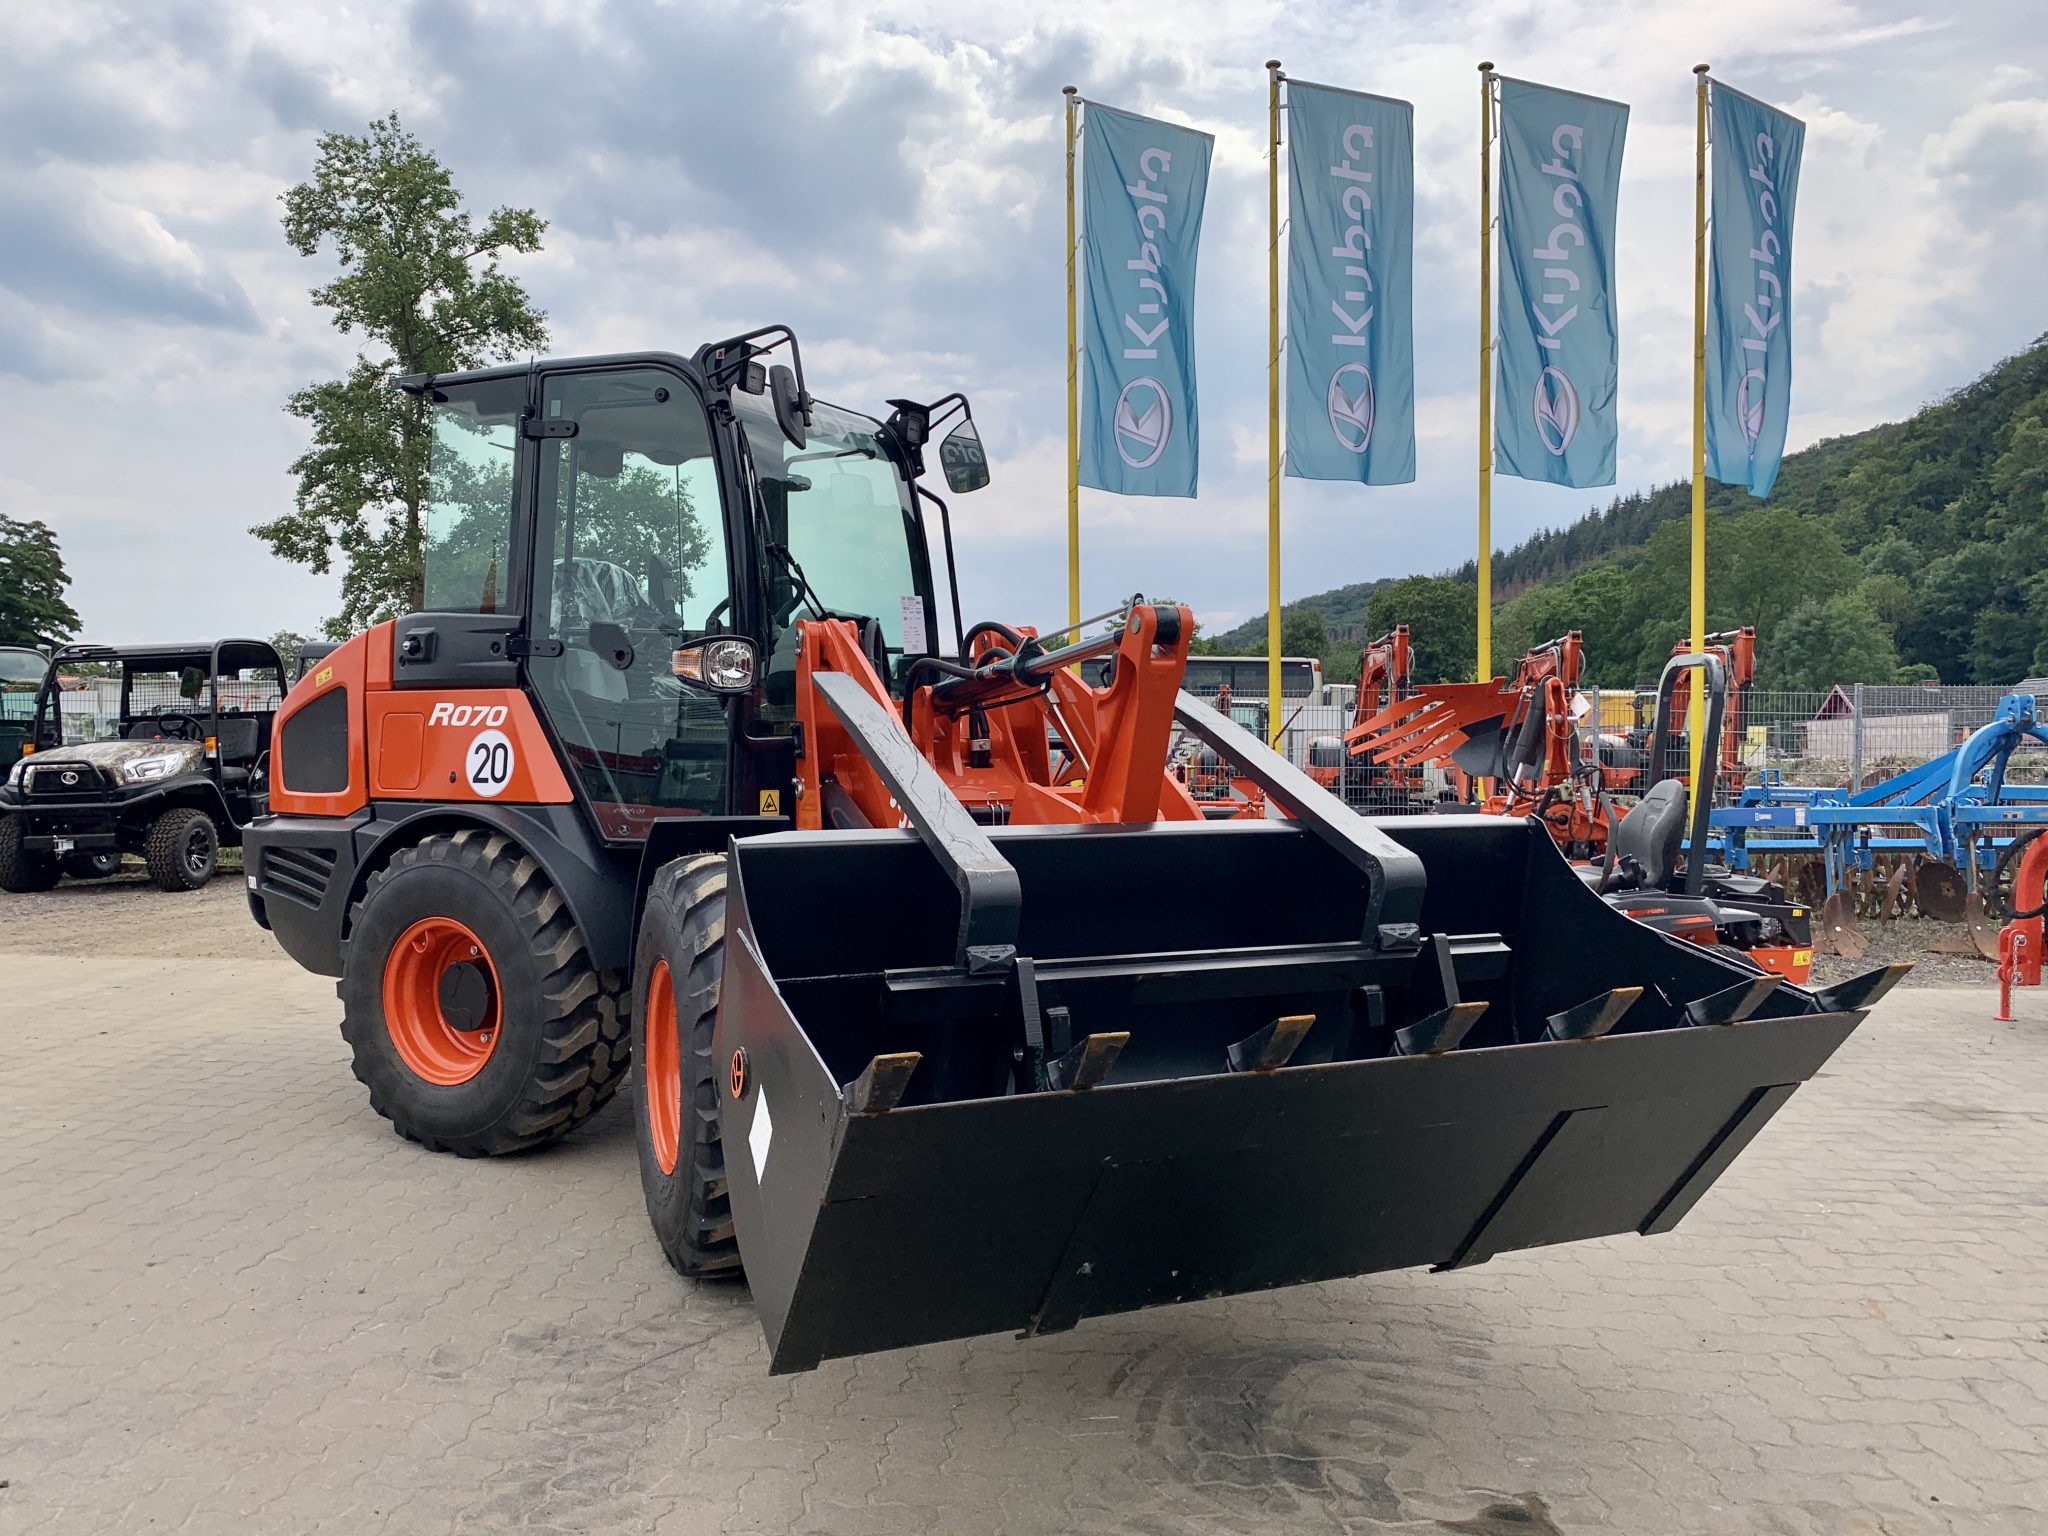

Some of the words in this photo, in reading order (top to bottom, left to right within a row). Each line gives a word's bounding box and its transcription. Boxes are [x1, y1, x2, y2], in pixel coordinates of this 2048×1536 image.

[1123, 147, 1172, 359] Kubota
[1330, 124, 1374, 346] Kubota
[1533, 123, 1585, 350] Kubota
[1741, 132, 1782, 352] Kubota
[428, 702, 509, 727] R070
[472, 743, 509, 784] 20
